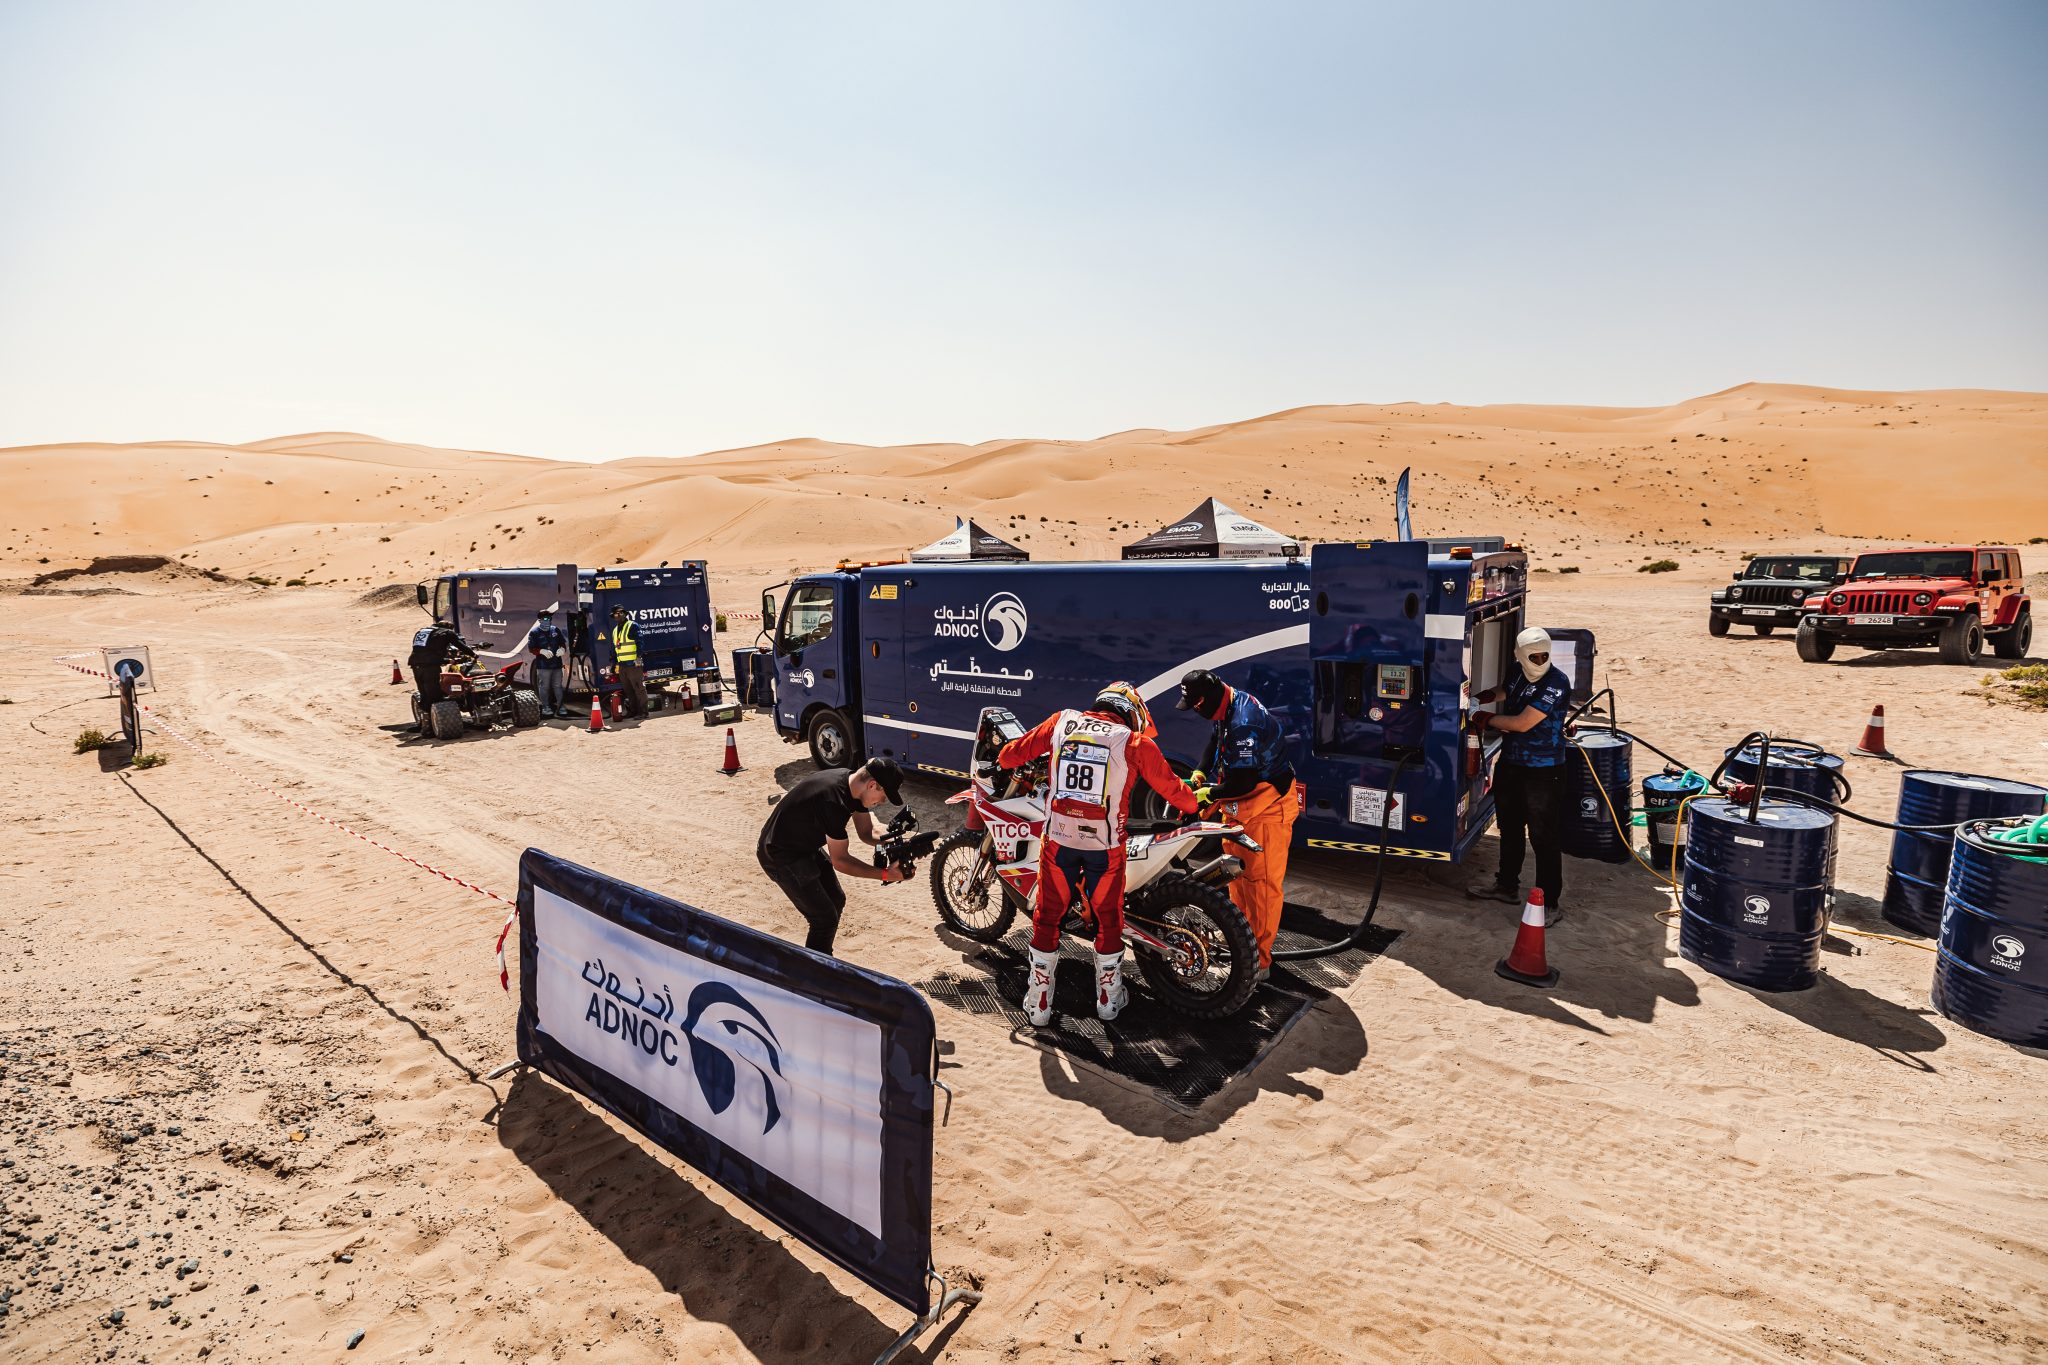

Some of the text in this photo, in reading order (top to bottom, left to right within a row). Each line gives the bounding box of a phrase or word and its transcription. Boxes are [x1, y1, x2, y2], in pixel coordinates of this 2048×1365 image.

[1166, 525, 1197, 533] EMSO
[1261, 582, 1292, 593] التجارية
[639, 606, 689, 620] STATION
[934, 623, 979, 638] ADNOC
[941, 681, 1022, 697] المحطة المتنقلة لراحة البال
[1065, 763, 1094, 791] 88
[1355, 795, 1380, 803] GASOLINE
[1650, 797, 1669, 806] elf
[992, 823, 1030, 838] ITCC
[1743, 917, 1768, 926] ADNOC
[1990, 958, 2020, 972] ADNOC
[582, 958, 674, 1024] أدنوك
[585, 992, 678, 1066] ADNOC
